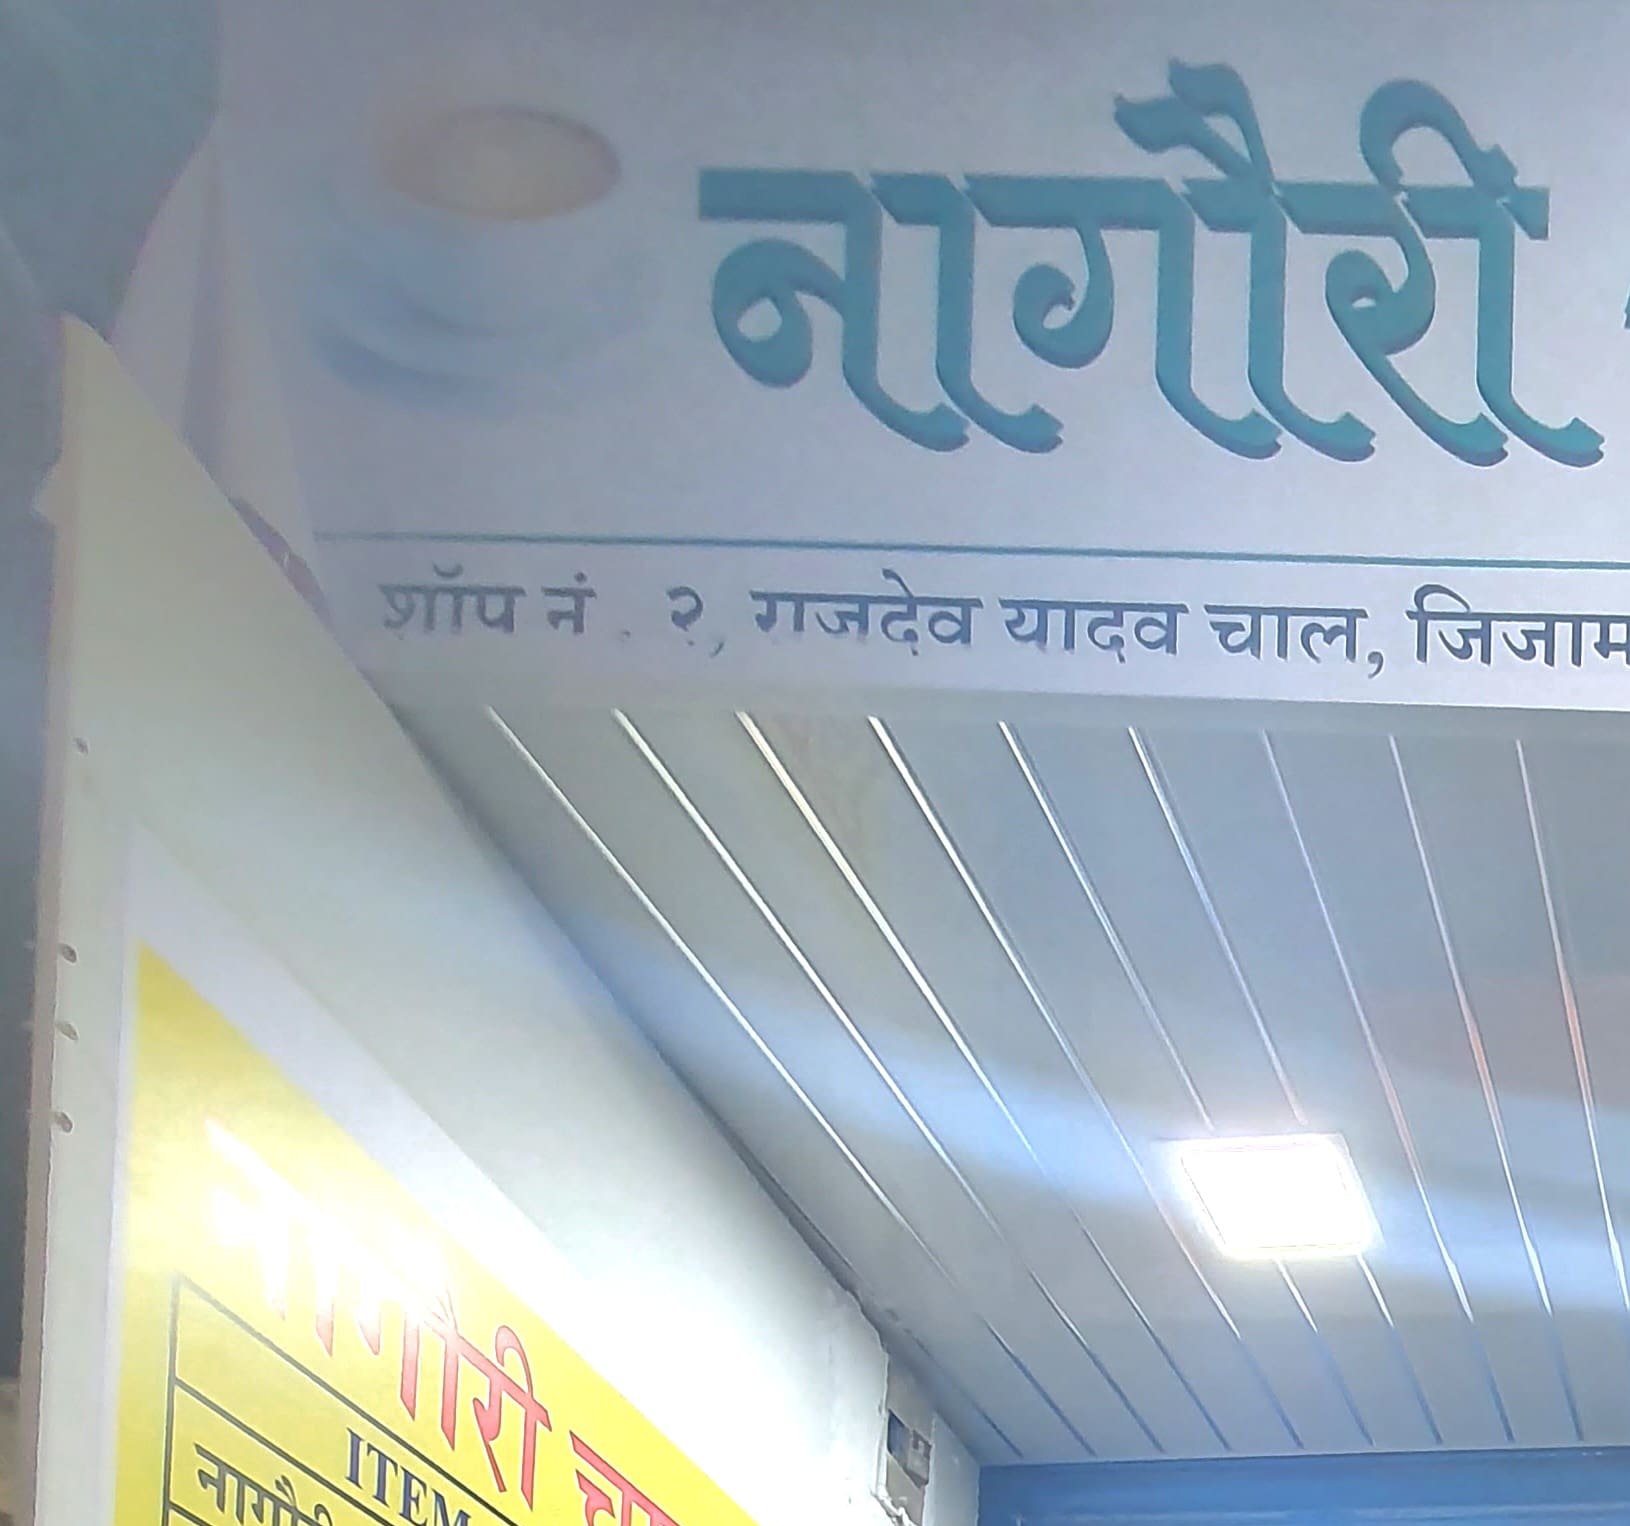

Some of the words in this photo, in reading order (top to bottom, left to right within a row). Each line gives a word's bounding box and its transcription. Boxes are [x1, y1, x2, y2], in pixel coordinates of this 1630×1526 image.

[698, 58, 1604, 467] नागौरी
[1000, 598, 1190, 665] यादव
[1203, 603, 1385, 679] चाल,
